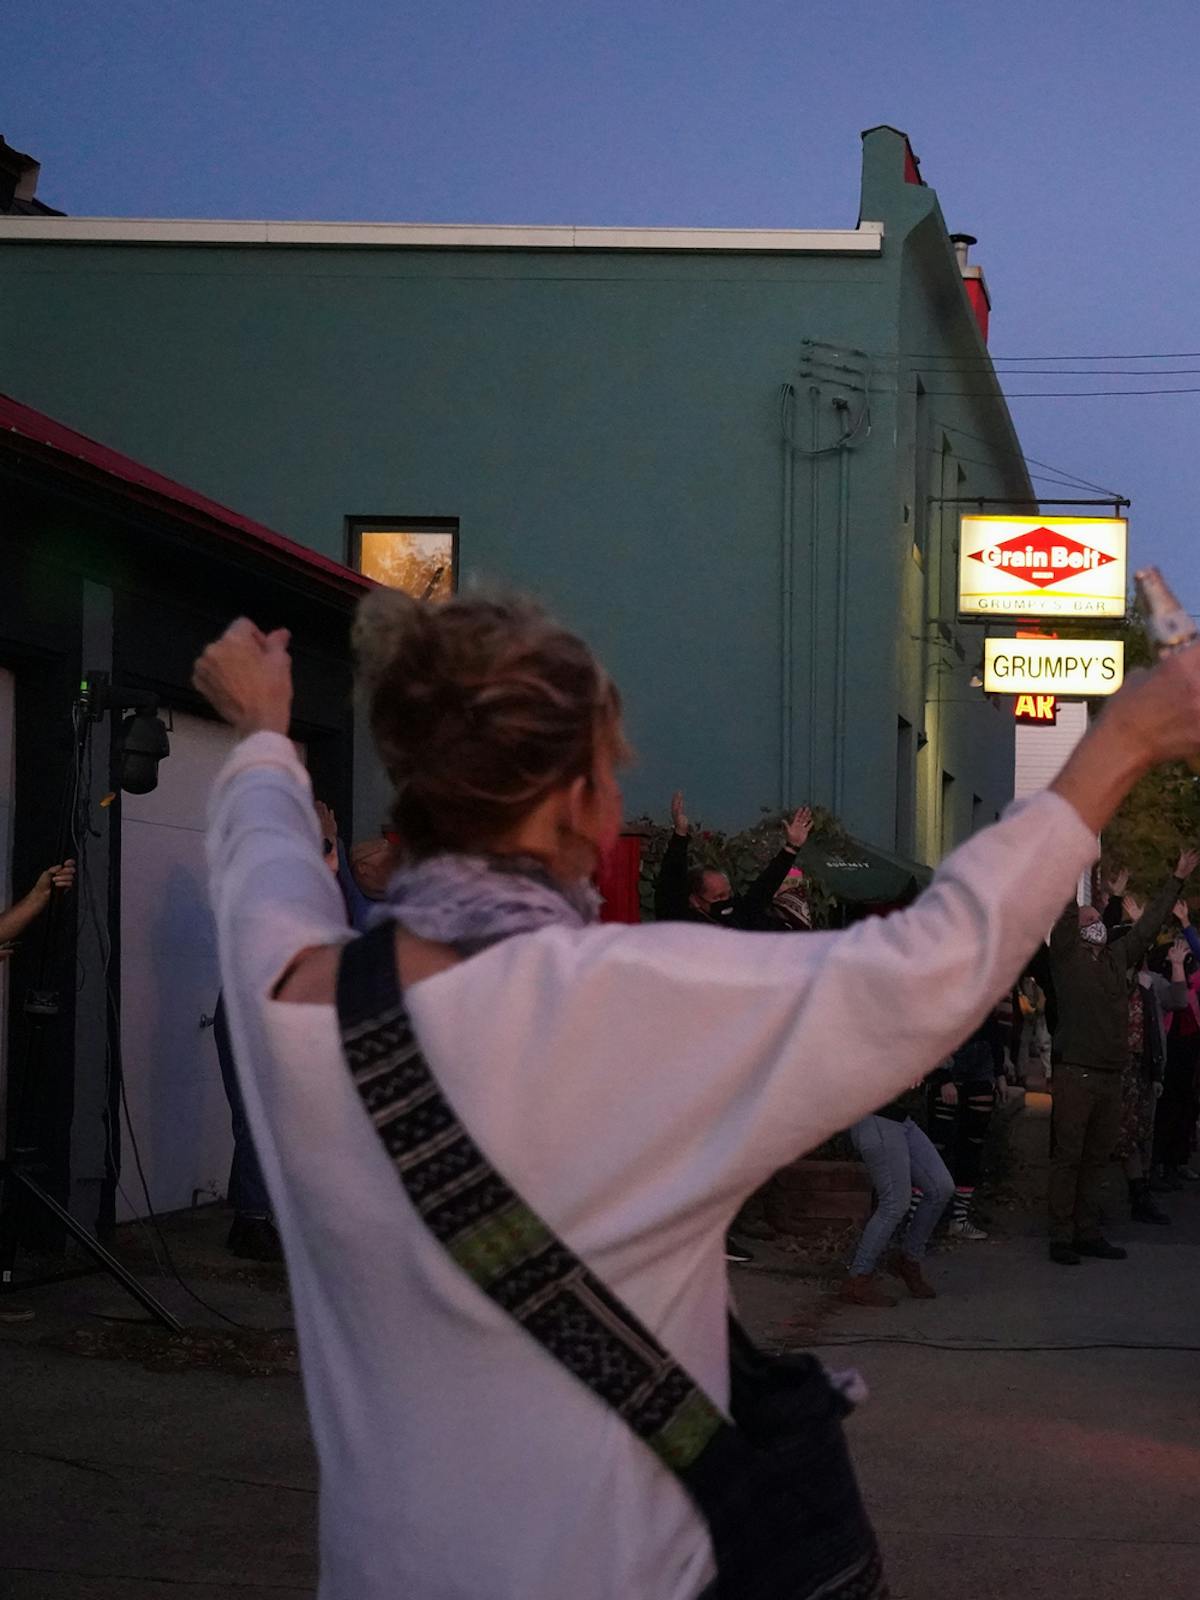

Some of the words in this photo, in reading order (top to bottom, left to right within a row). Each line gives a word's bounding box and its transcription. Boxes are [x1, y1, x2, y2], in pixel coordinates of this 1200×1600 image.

[982, 545, 1048, 568] Grain
[1073, 601, 1106, 611] BAR
[993, 654, 1116, 681] GRUMPY'S
